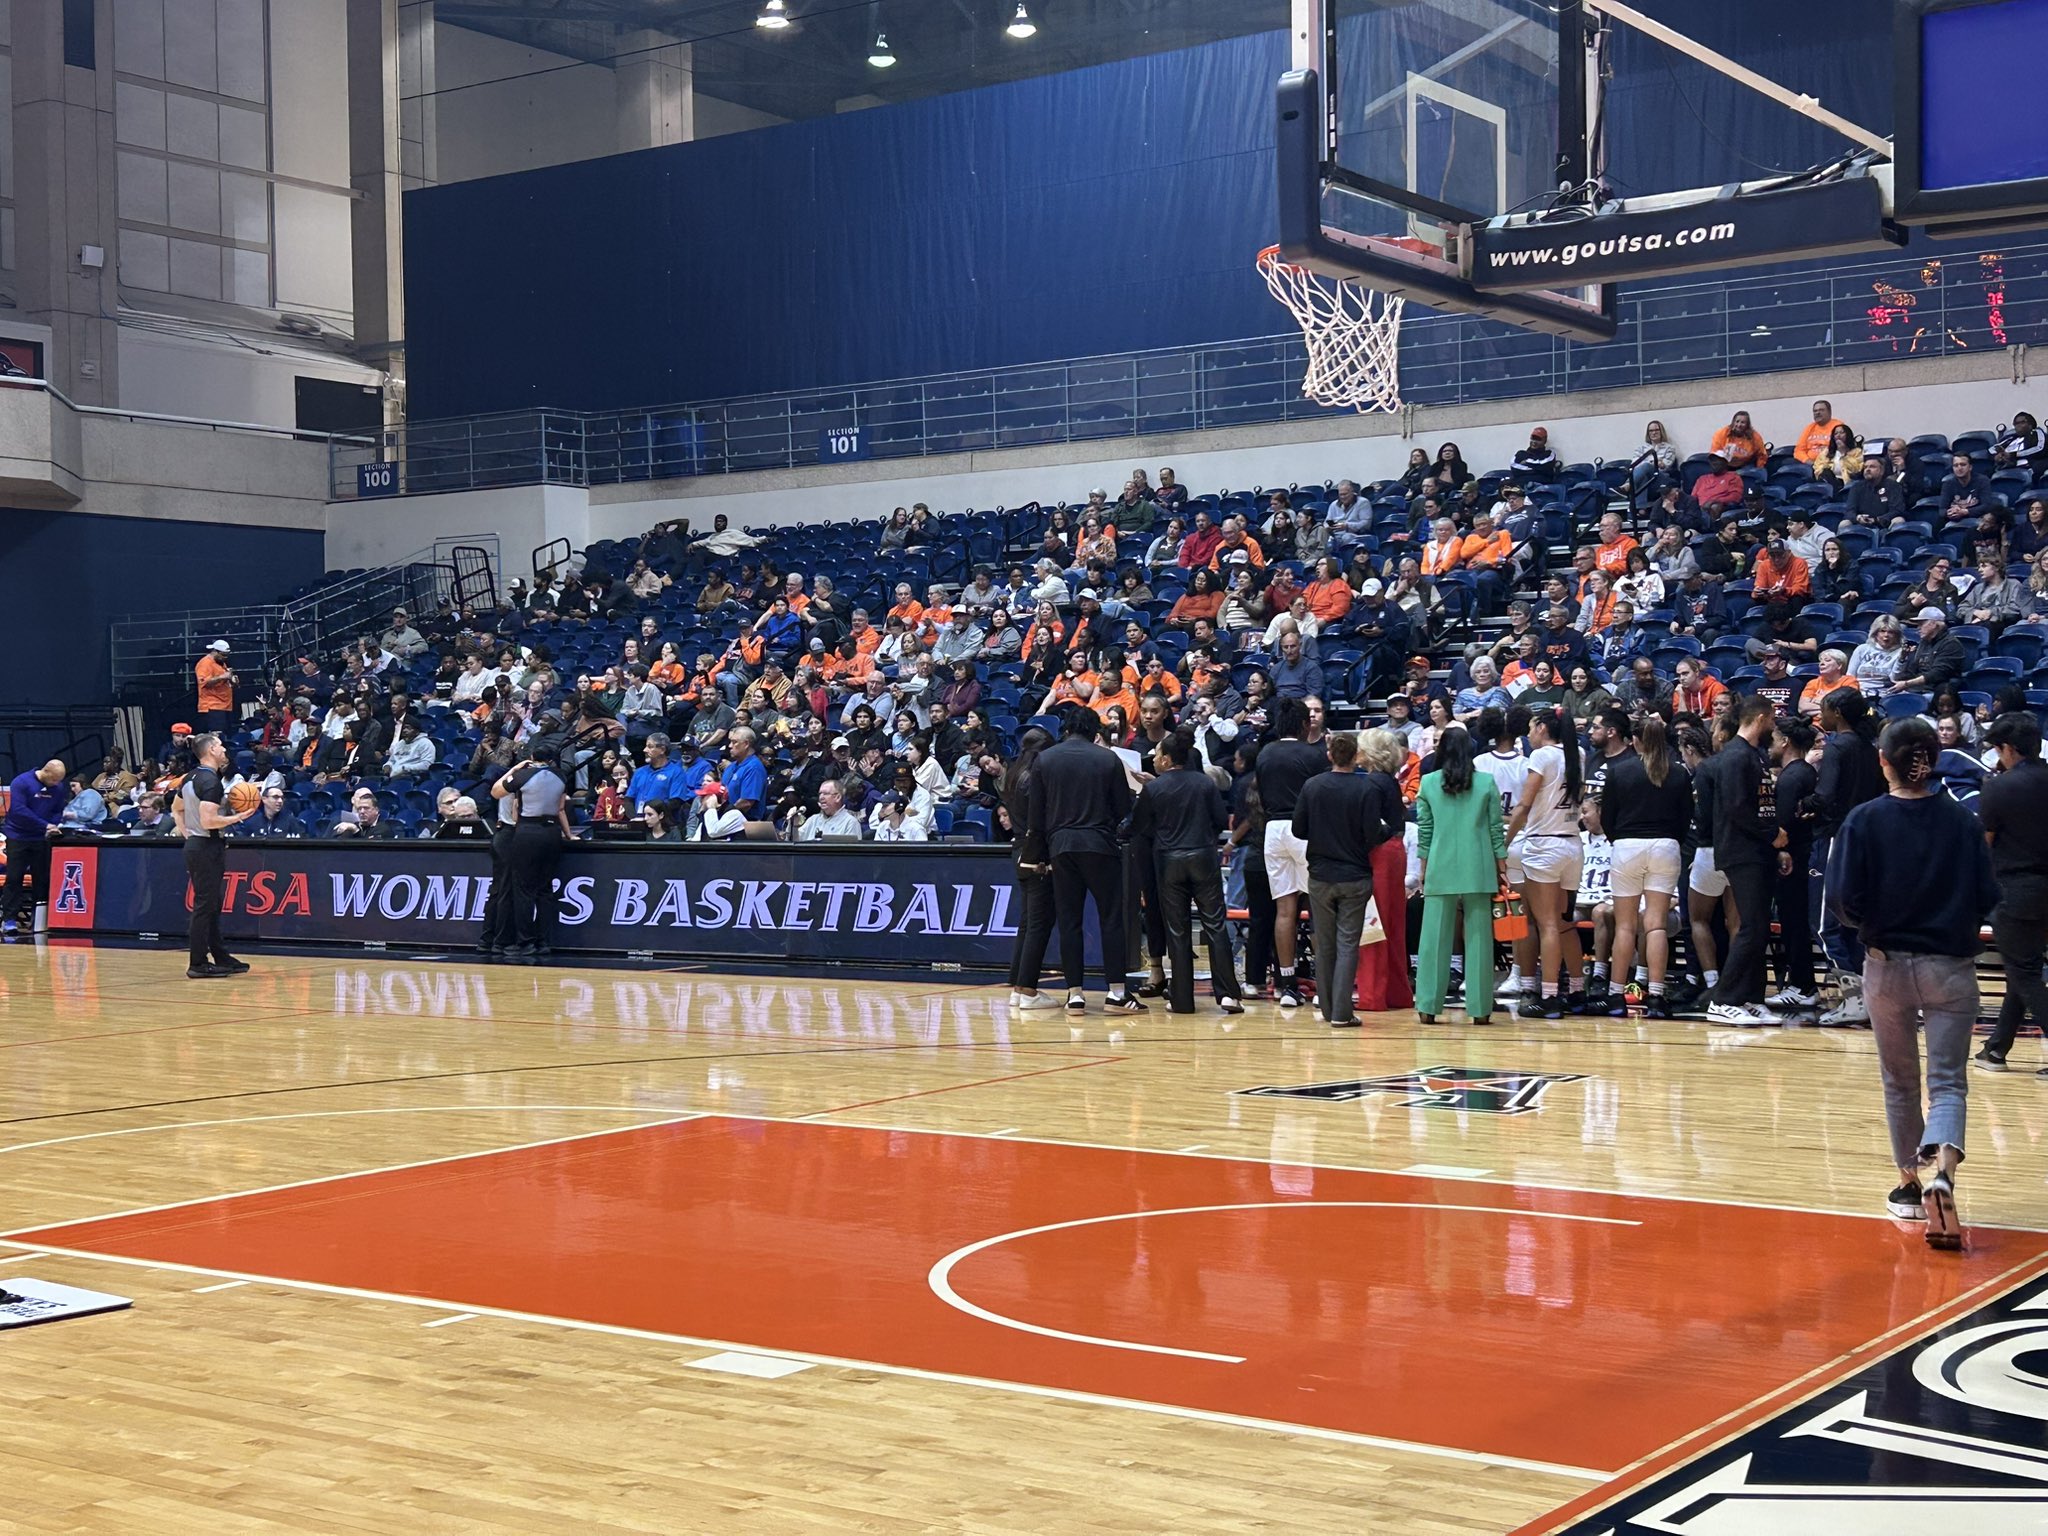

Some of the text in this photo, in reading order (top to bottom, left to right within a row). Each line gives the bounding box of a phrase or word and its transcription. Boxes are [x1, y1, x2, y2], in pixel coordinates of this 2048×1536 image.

[1489, 222, 1736, 267] www.goutsa.com
[828, 427, 859, 436] SECTION
[830, 436, 857, 454] 101
[364, 470, 391, 487] 100
[328, 873, 596, 926] WOME'S
[610, 876, 1019, 937] BASKETBALL
